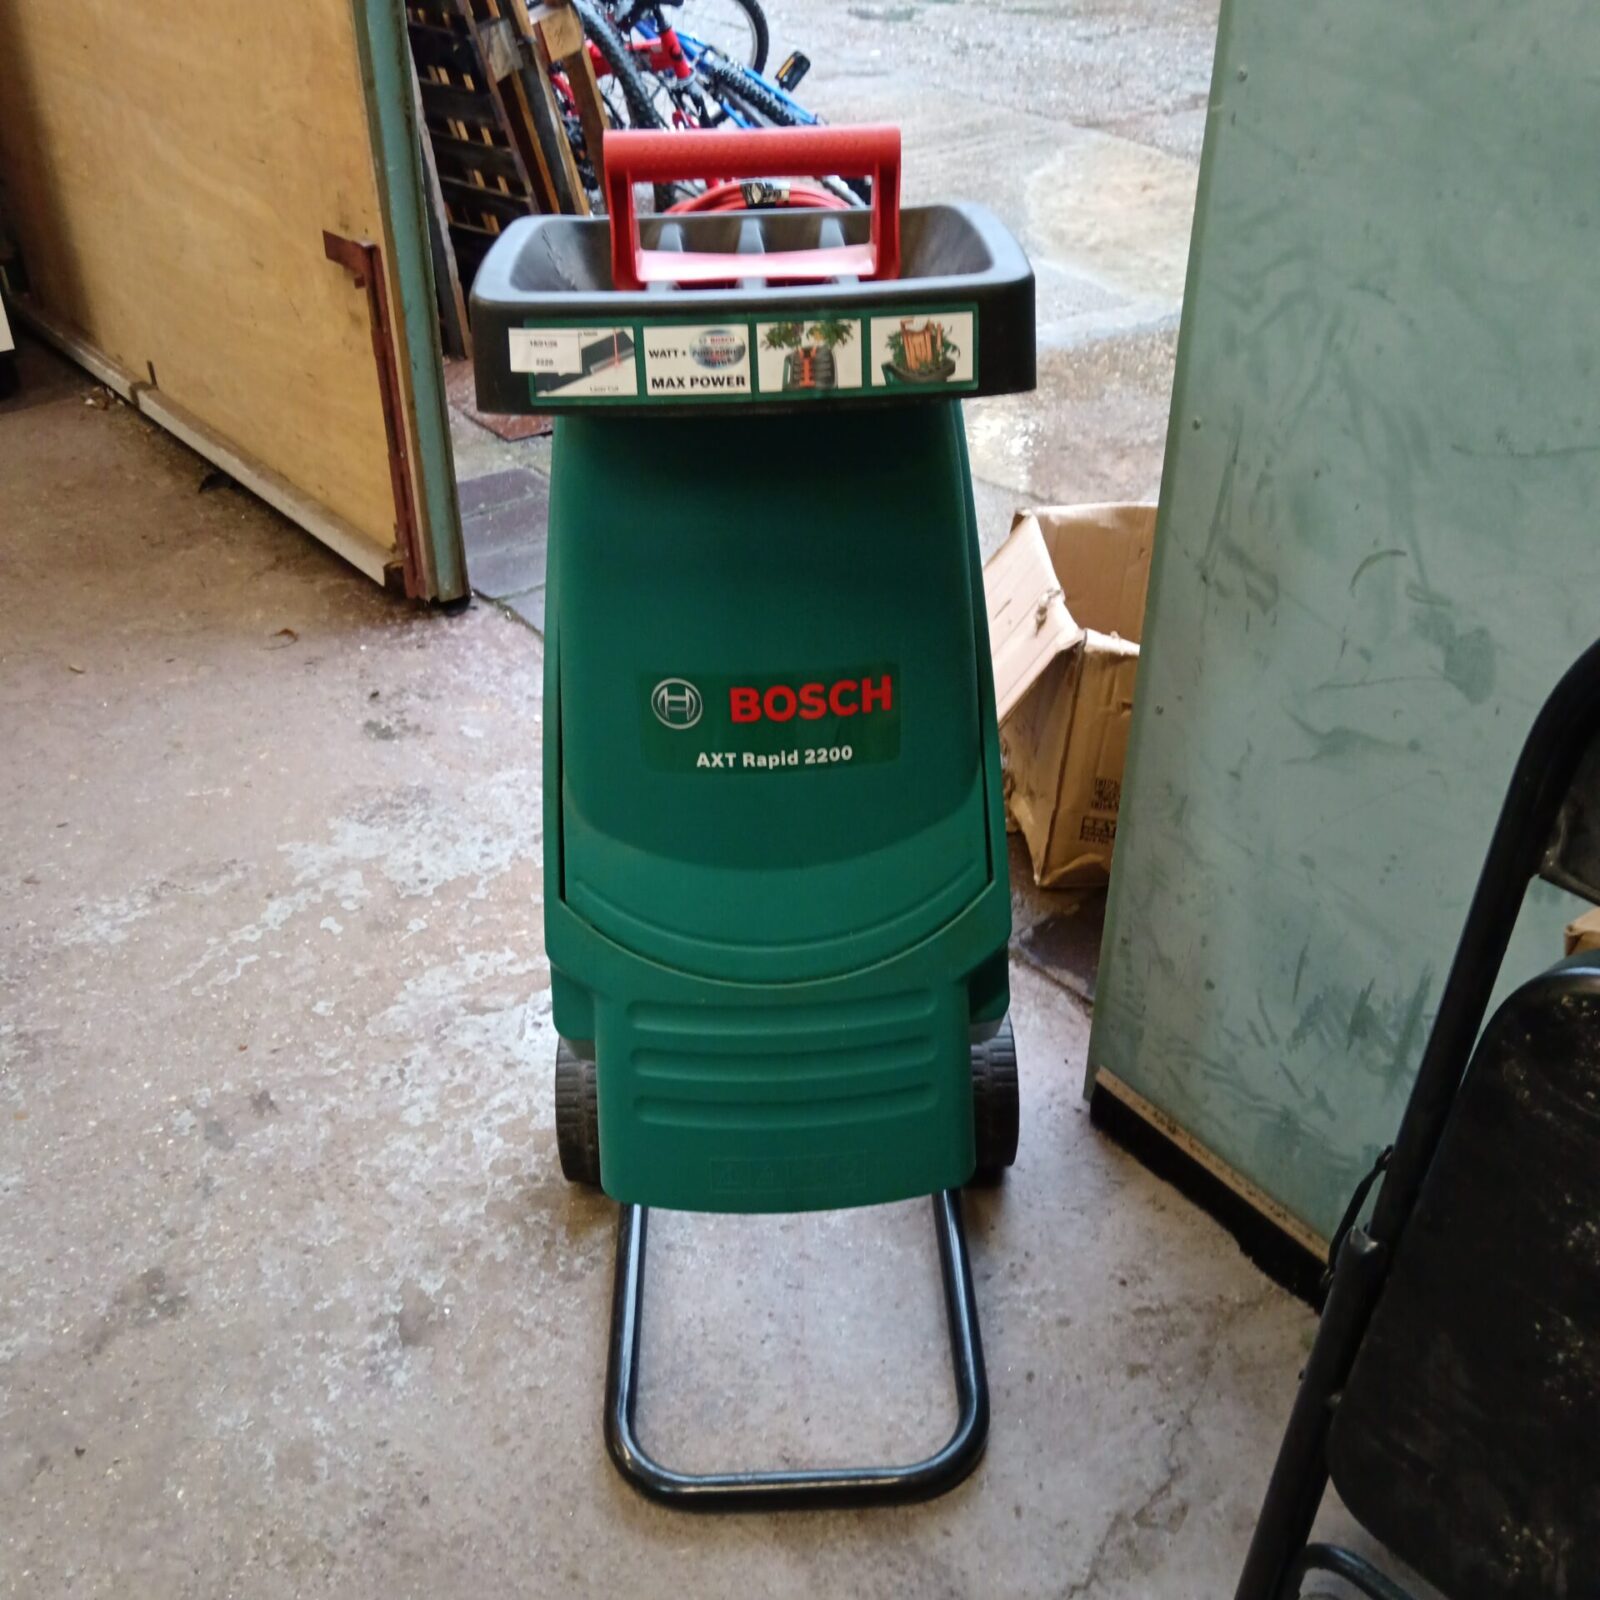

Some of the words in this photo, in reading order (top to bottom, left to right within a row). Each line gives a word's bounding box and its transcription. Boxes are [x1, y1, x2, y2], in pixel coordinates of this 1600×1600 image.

[648, 349, 679, 359] WATT
[651, 376, 686, 389] MAX
[689, 375, 746, 388] POWER
[729, 674, 893, 724] BOSCH
[696, 752, 737, 768] AXT
[742, 750, 798, 769] Rapid
[804, 745, 853, 764] 2200
